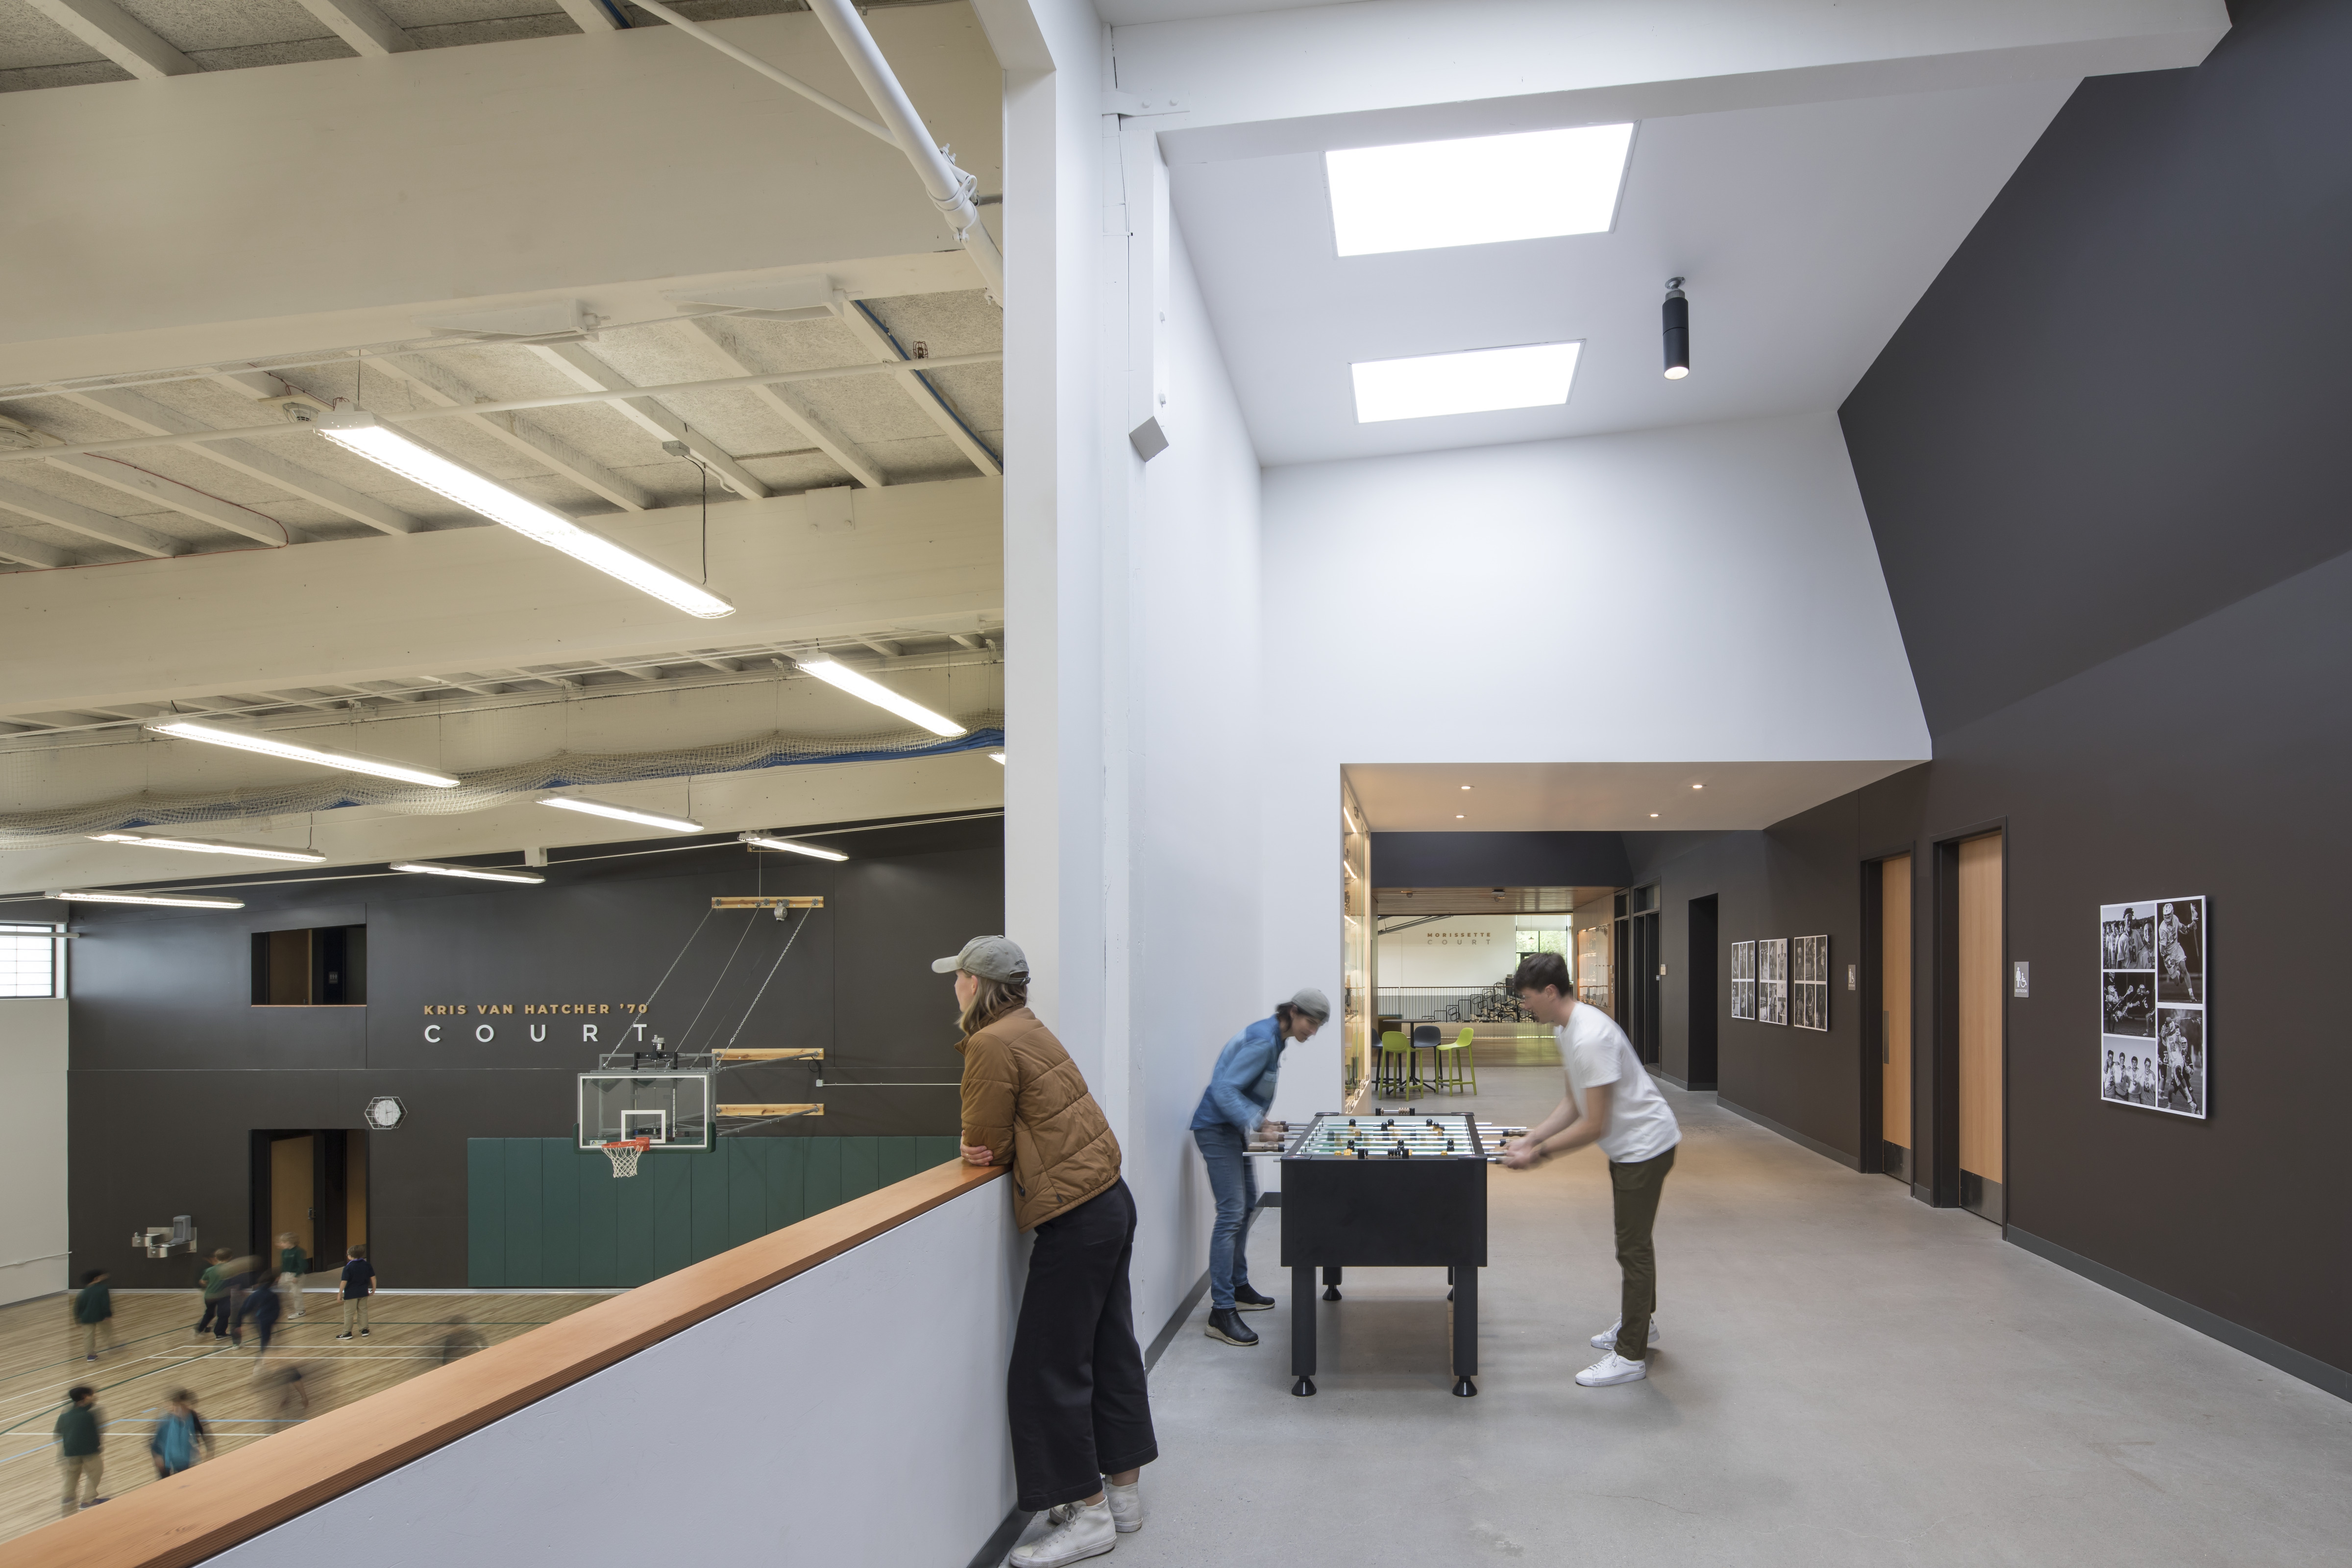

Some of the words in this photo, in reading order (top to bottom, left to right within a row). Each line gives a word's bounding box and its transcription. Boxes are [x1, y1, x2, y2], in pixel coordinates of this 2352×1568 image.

[424, 1005, 467, 1015] KRIS
[477, 1004, 514, 1014] VAN
[525, 1004, 610, 1014] HATCHER
[620, 1003, 648, 1014] '70
[424, 1024, 647, 1043] COURT
